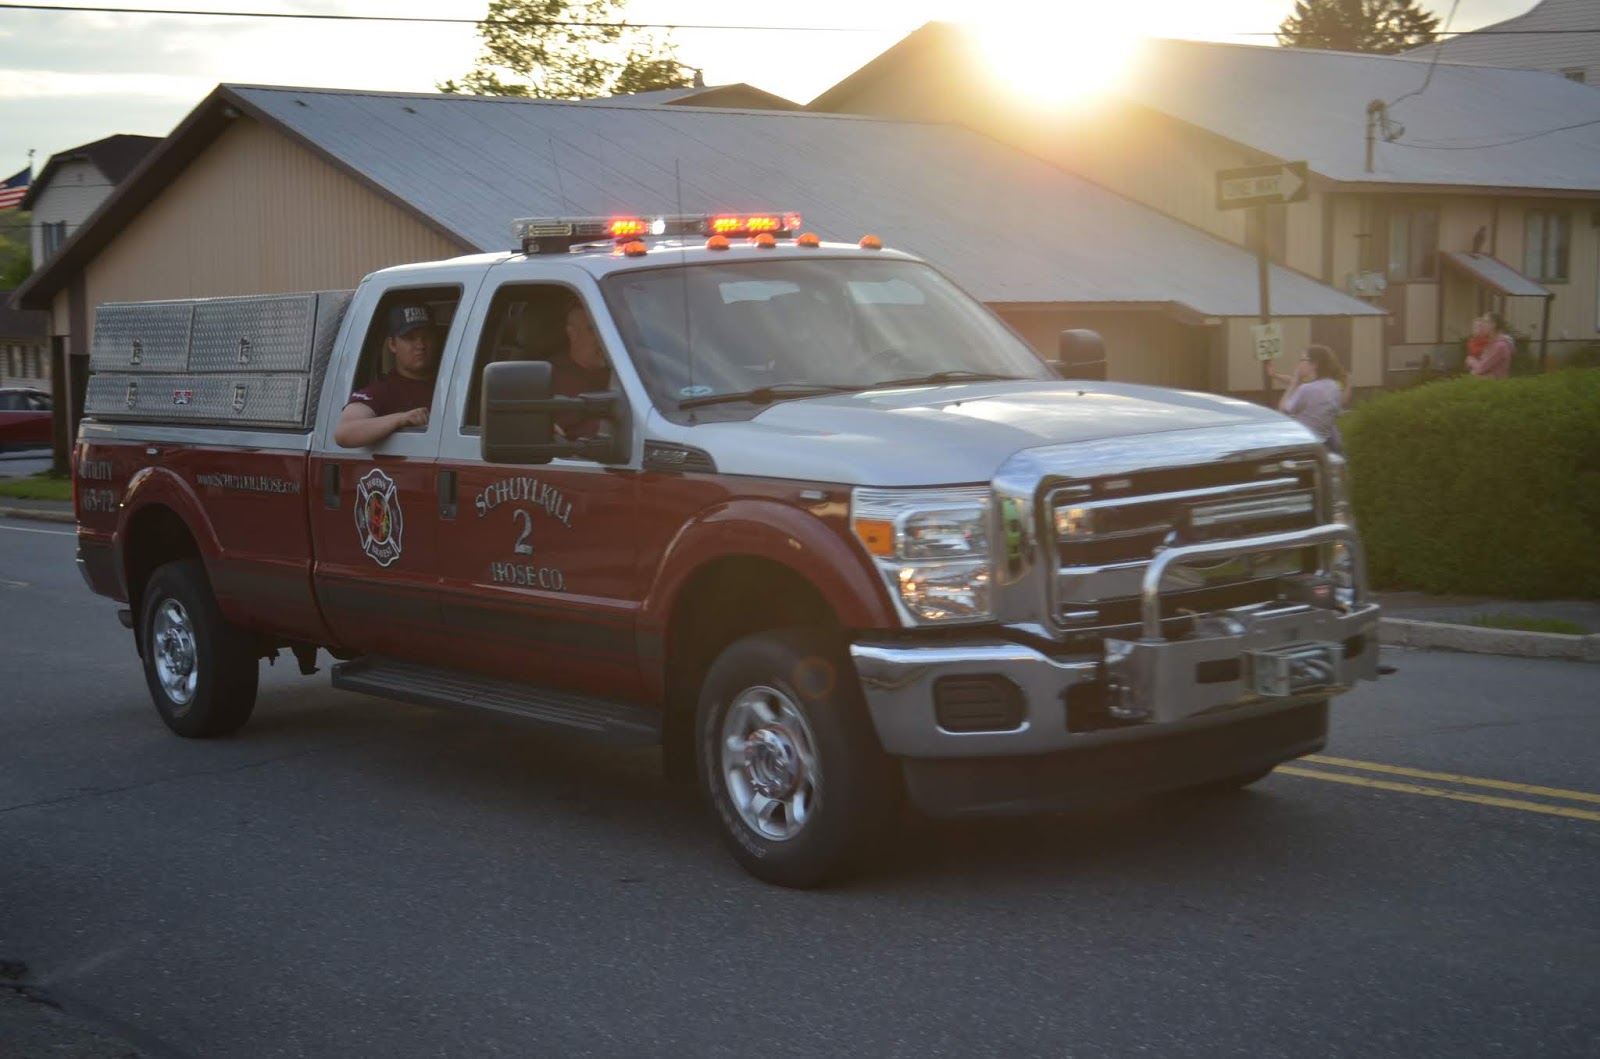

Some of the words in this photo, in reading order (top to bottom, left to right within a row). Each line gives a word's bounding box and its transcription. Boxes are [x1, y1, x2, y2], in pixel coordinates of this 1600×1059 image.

[475, 477, 573, 529] SCHUYLKILL
[513, 508, 534, 555] 2
[492, 561, 536, 586] HOSE
[539, 567, 567, 591] CO.
